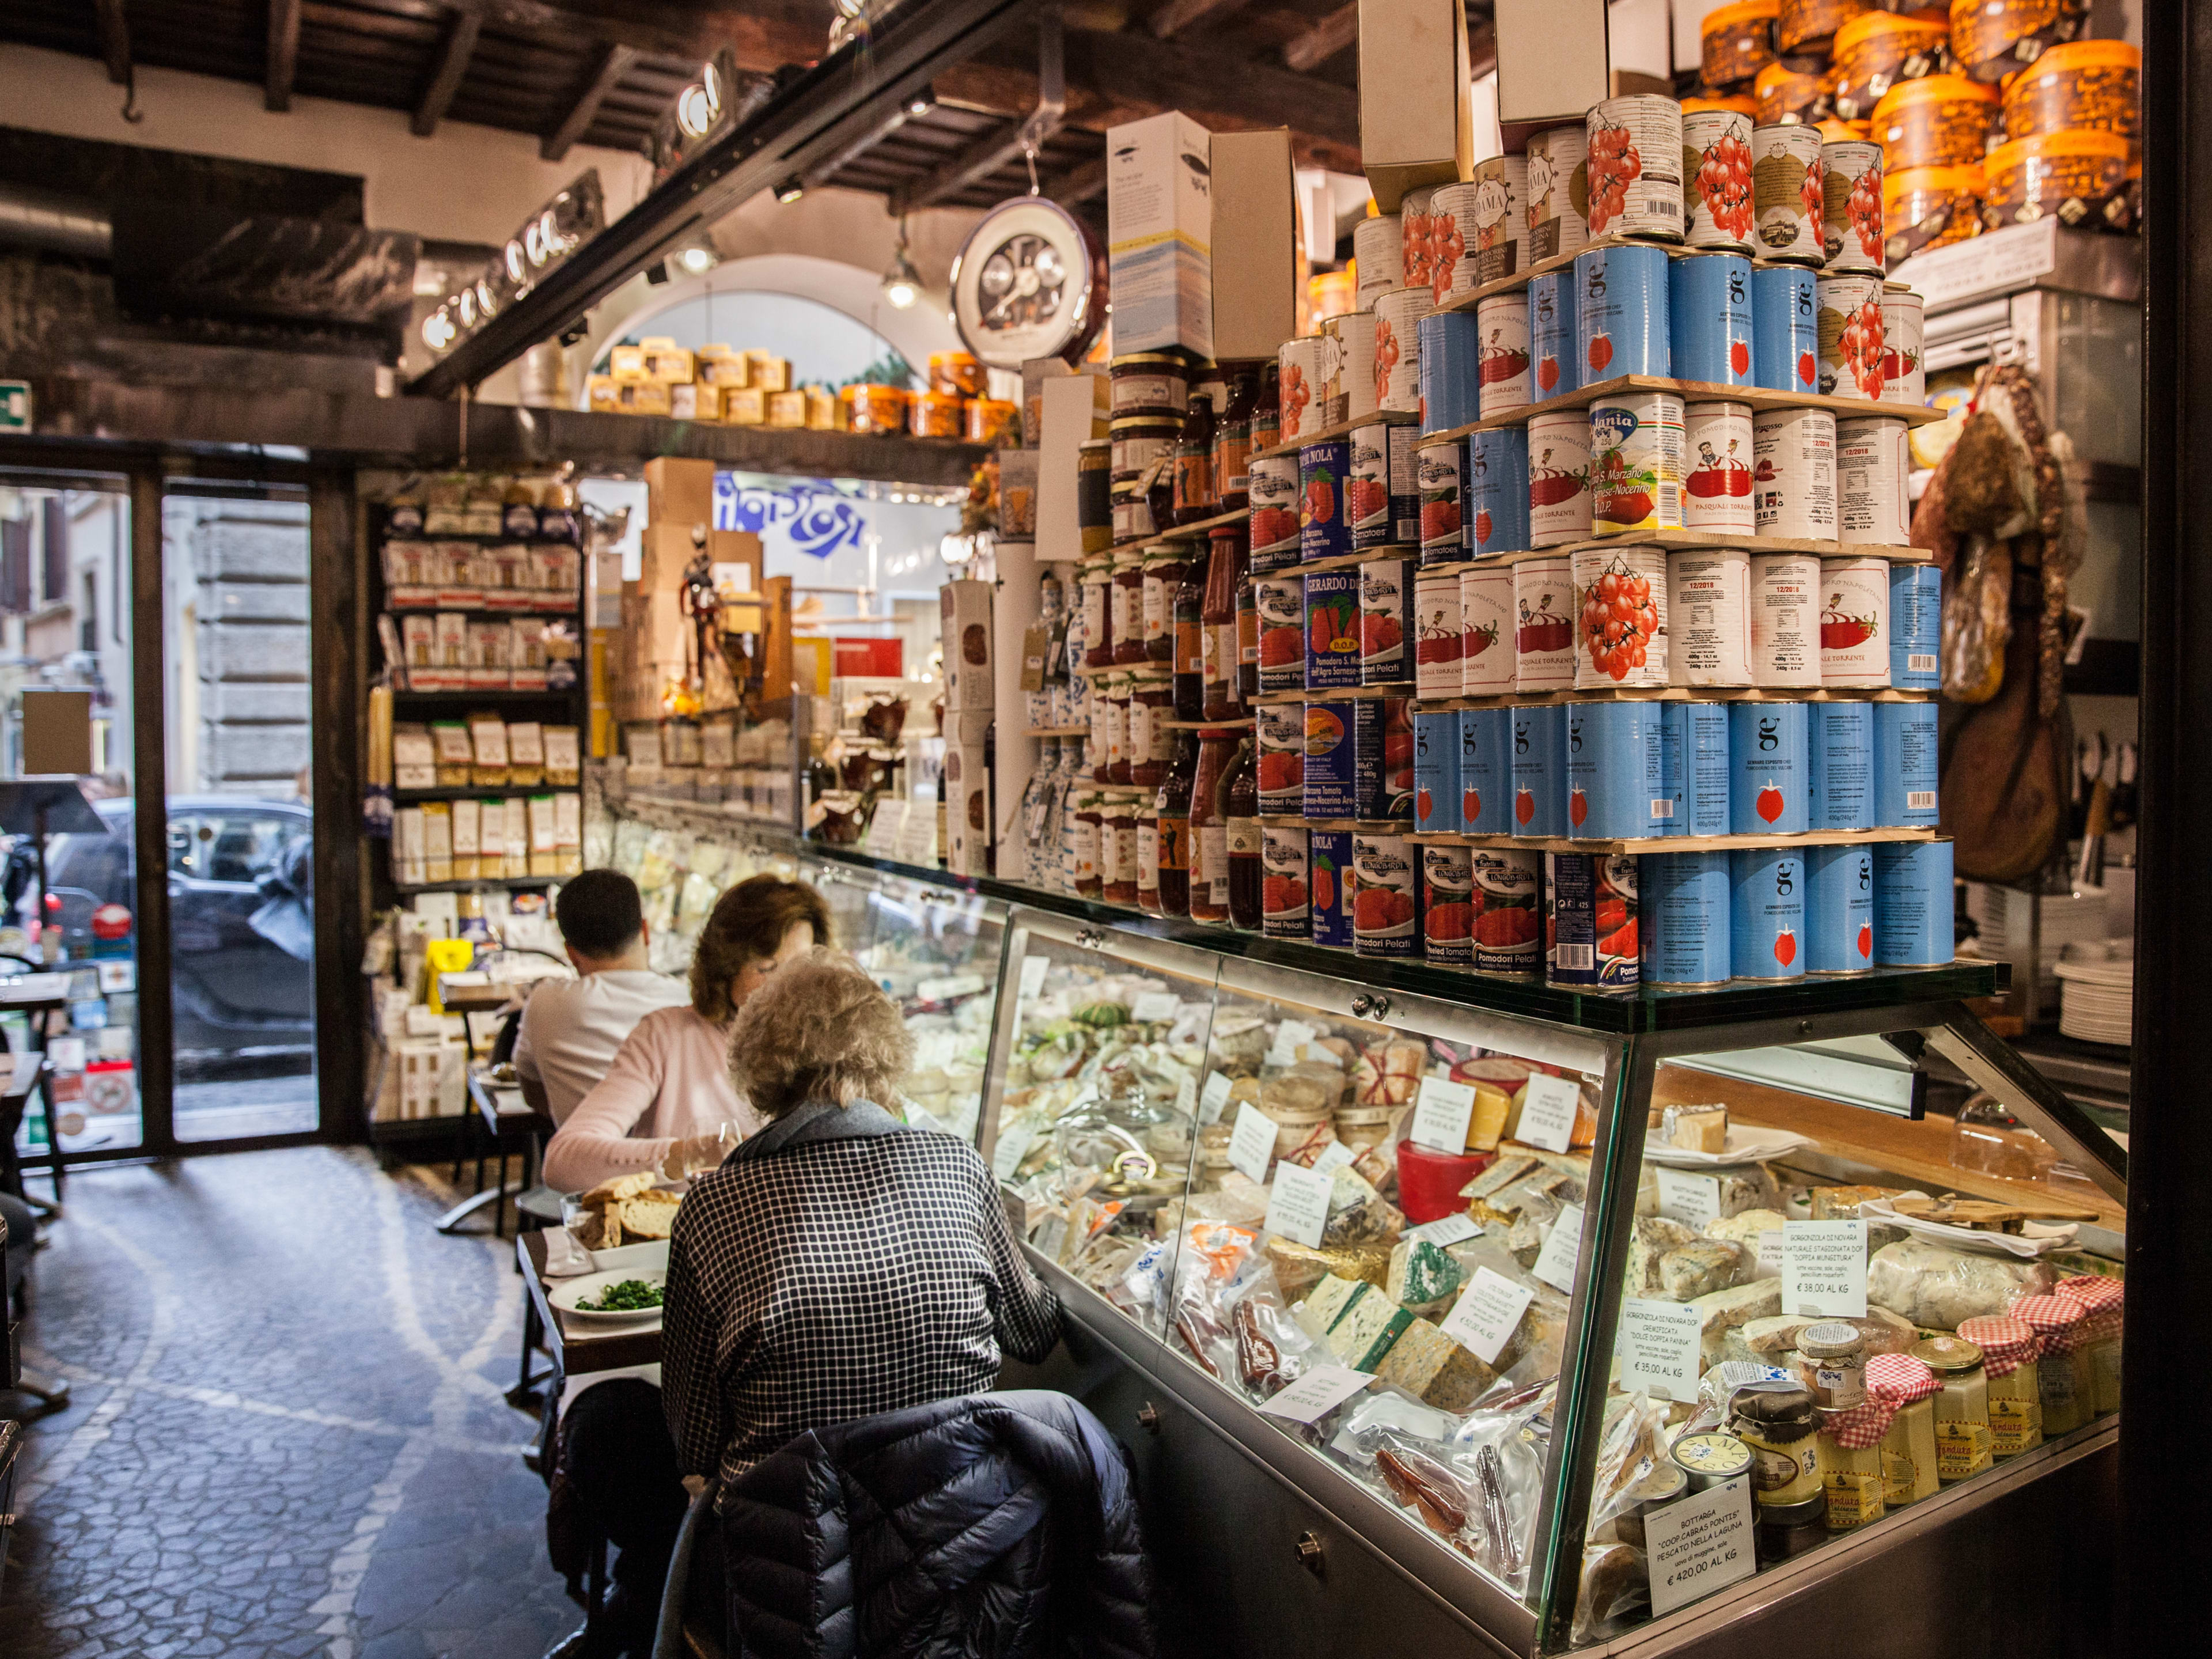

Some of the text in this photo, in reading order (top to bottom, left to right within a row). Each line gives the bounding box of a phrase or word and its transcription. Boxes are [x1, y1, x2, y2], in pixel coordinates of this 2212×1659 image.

[1310, 449, 1332, 463] NOLA
[1600, 469, 1642, 483] S. Marzano
[1595, 501, 1611, 514] D.O.P.
[1429, 547, 1457, 556] Tomatoes
[1274, 552, 1297, 563] Pelati
[1308, 577, 1346, 592] GERARDO
[1843, 579, 1883, 605] NAPOLETANO
[1334, 641, 1354, 649] D.O.P.
[1316, 657, 1342, 666] Pomodoro
[1377, 664, 1399, 672] Pelati
[1363, 771, 1377, 779] 480g
[1323, 786, 1342, 795] Tomato
[1315, 837, 1332, 849] NOLA
[1365, 862, 1403, 870] LONGOBARDI
[1490, 874, 1530, 882] LONGOBARDI
[1283, 921, 1304, 929] Pelati
[1385, 939, 1410, 948] Pelati
[1427, 946, 1471, 956] Peeled Tomato
[1479, 953, 1537, 964] Pomodori Pelati
[1797, 1283, 1849, 1293] € 38,00 AL KG
[1626, 1311, 1658, 1321] GORGONZOLA
[1666, 1316, 1687, 1325] NOVARA
[1643, 1324, 1678, 1335] CREMIFICATA
[1630, 1332, 1691, 1346] "DOLCE DOPPIA PANNA"
[1635, 1362, 1683, 1378] € 35,00 AL KG
[1681, 1509, 1716, 1529] BOTTARGA
[1710, 1509, 1740, 1528] PONTIS"
[1657, 1520, 1743, 1562] PESCATO NELLA LAGUNA
[1675, 1559, 1687, 1567] uova
[1717, 1540, 1728, 1549] sale
[1667, 1548, 1737, 1586] € 420,00 AL KG
